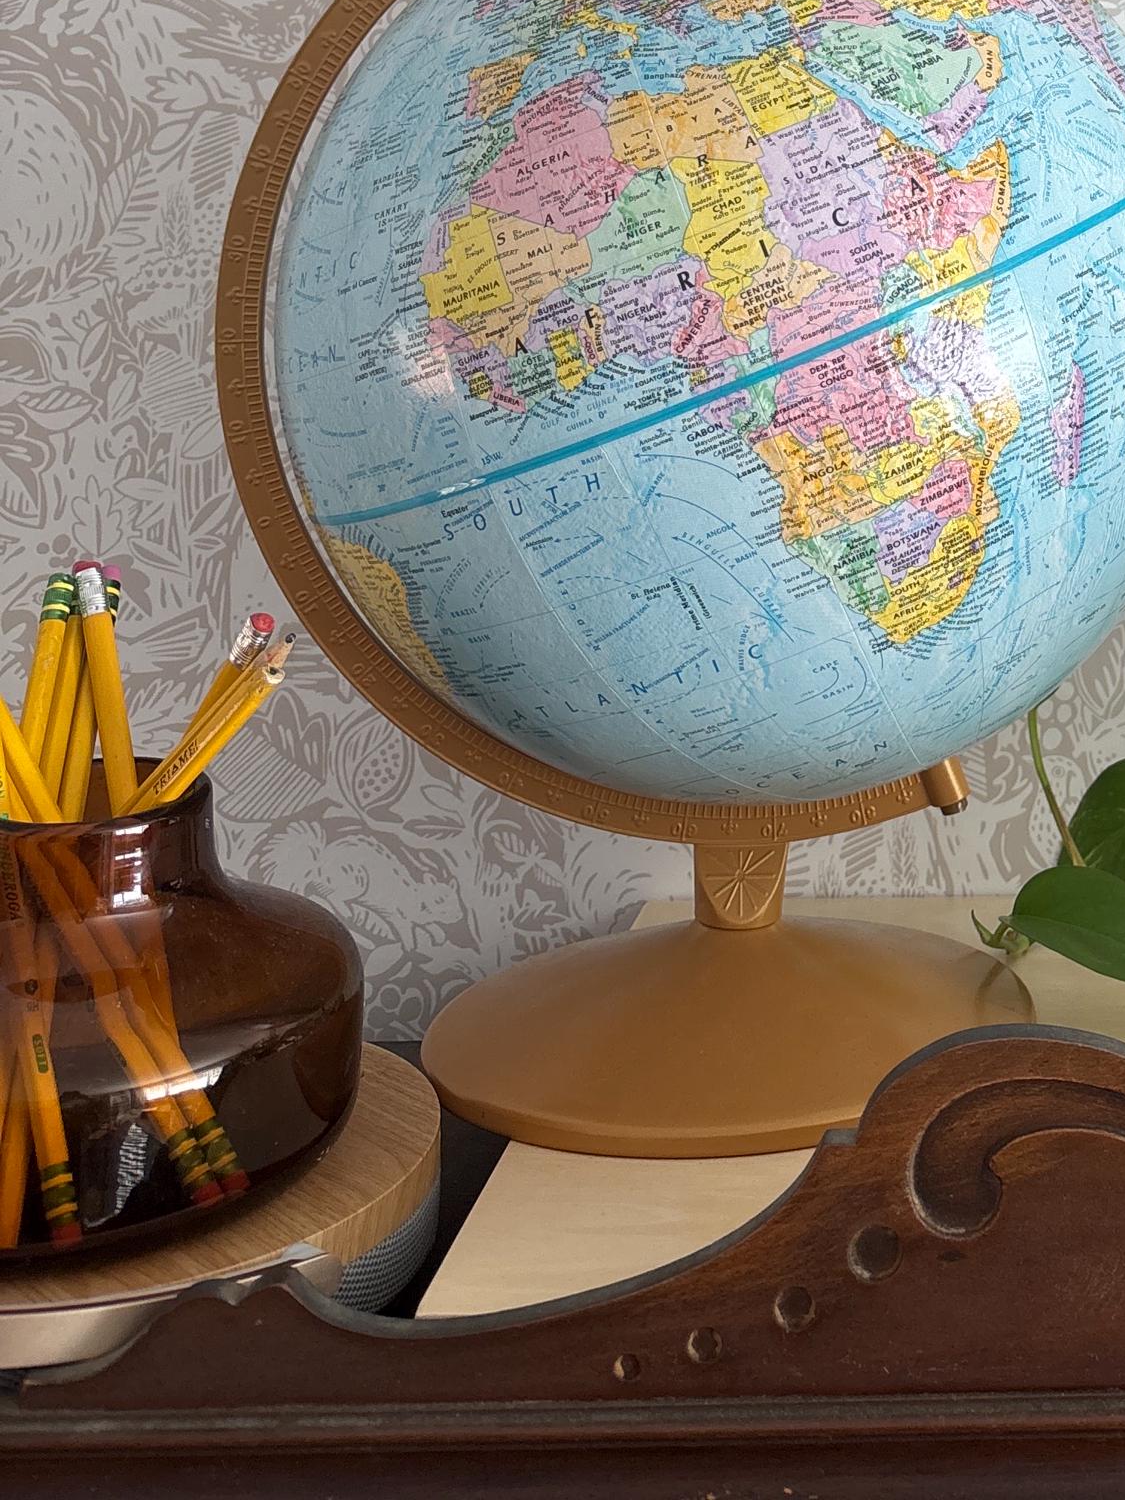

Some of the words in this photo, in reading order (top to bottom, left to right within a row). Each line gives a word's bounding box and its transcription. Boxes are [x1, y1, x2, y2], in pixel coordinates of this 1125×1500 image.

[795, 3, 818, 16] SYRIA
[911, 54, 943, 72] ARABIA
[985, 49, 993, 78] OMAN
[871, 72, 900, 89] SAUDI
[753, 94, 785, 114] EGYPT
[950, 104, 977, 134] YEMEN
[470, 125, 511, 176] MOROCCO
[516, 150, 571, 178] ALGERIA
[782, 154, 846, 185] SUDAN
[996, 161, 1007, 212] SOMALIA
[374, 202, 408, 220] CANARY
[712, 196, 742, 213] CHAD
[904, 189, 967, 221] ETHIOPIA
[626, 220, 662, 240] NIGER
[527, 244, 553, 260] MALI
[850, 239, 878, 256] SOUTH
[854, 250, 884, 266] SUDAN
[935, 263, 967, 282] KENYA
[443, 280, 500, 309] MAURITANIA
[739, 277, 784, 300] CENTRAL
[742, 285, 786, 309] AFRICAN
[887, 275, 920, 304] UGANDA
[537, 297, 575, 316] BURKINA
[616, 302, 658, 323] NIGERIA
[747, 291, 795, 317] REPUBLIC
[556, 313, 579, 328] FASO
[643, 310, 668, 323] Abuja
[675, 299, 713, 355] CAMEROON
[596, 323, 605, 353] BENIN
[457, 350, 490, 367] GUINEA
[555, 352, 584, 368] GHANA
[818, 369, 830, 381] OF
[831, 365, 846, 377] THE
[820, 370, 854, 388] CONGO
[493, 392, 520, 407] LIBERIA
[686, 422, 724, 442] GABON
[803, 460, 848, 484] ANGOLA
[884, 457, 923, 480] ZAMBIA
[975, 443, 995, 516] MOZAMBIQUE
[920, 478, 969, 506] ZIMBABWE
[441, 504, 469, 518] Equator
[705, 522, 738, 539] ANGOLA
[886, 521, 941, 552] BOTSWANA
[735, 550, 758, 565] BASIN
[833, 548, 878, 573] NAMIBIA
[890, 581, 920, 598] SOUTH
[893, 601, 928, 620] AFRICA
[812, 659, 840, 673] CAPE
[822, 683, 855, 700] BASIN
